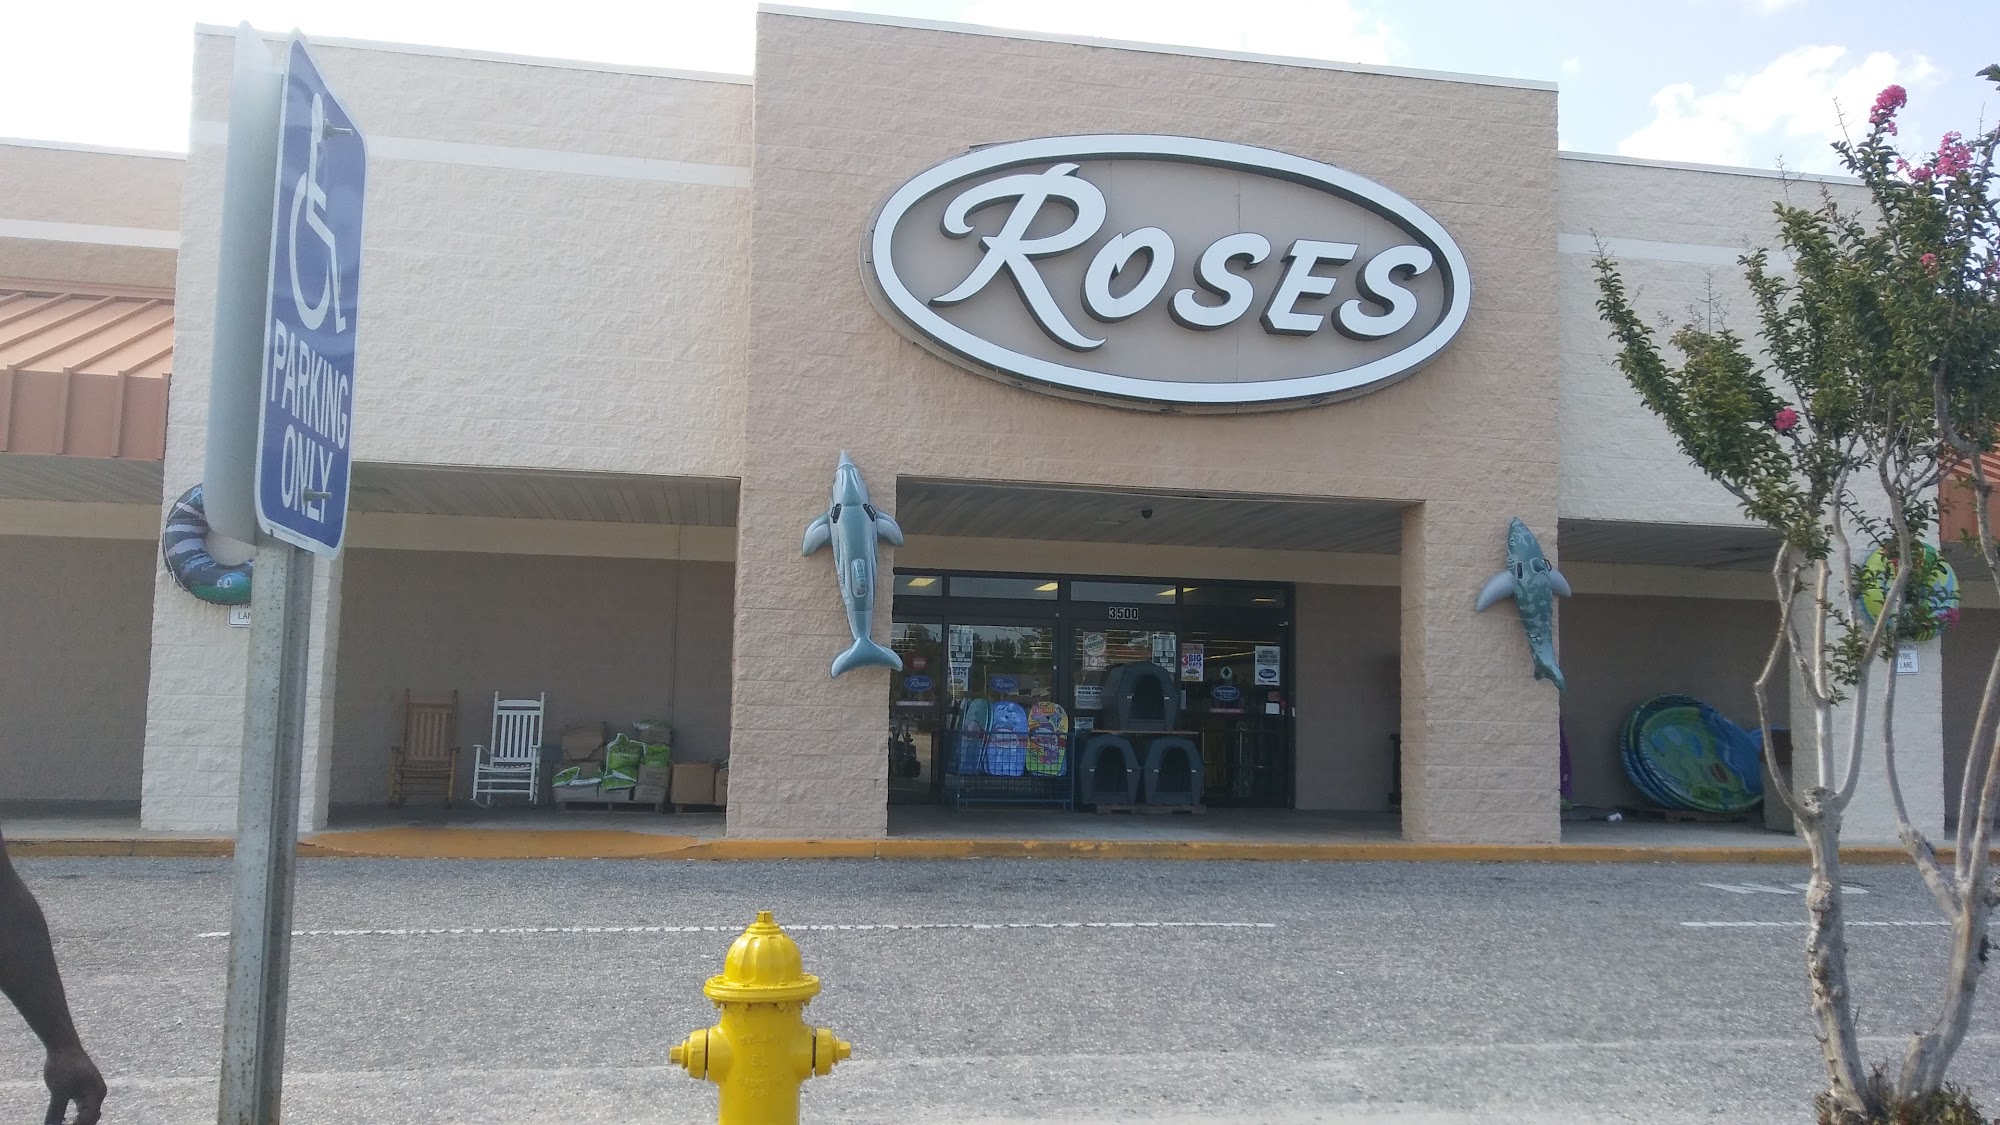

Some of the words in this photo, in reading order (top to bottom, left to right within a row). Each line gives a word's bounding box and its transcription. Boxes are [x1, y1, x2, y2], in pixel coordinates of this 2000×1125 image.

[271, 319, 348, 449] PARKING
[282, 424, 333, 523] ONLY
[1109, 607, 1138, 618] 3500
[1183, 655, 1189, 666] 3
